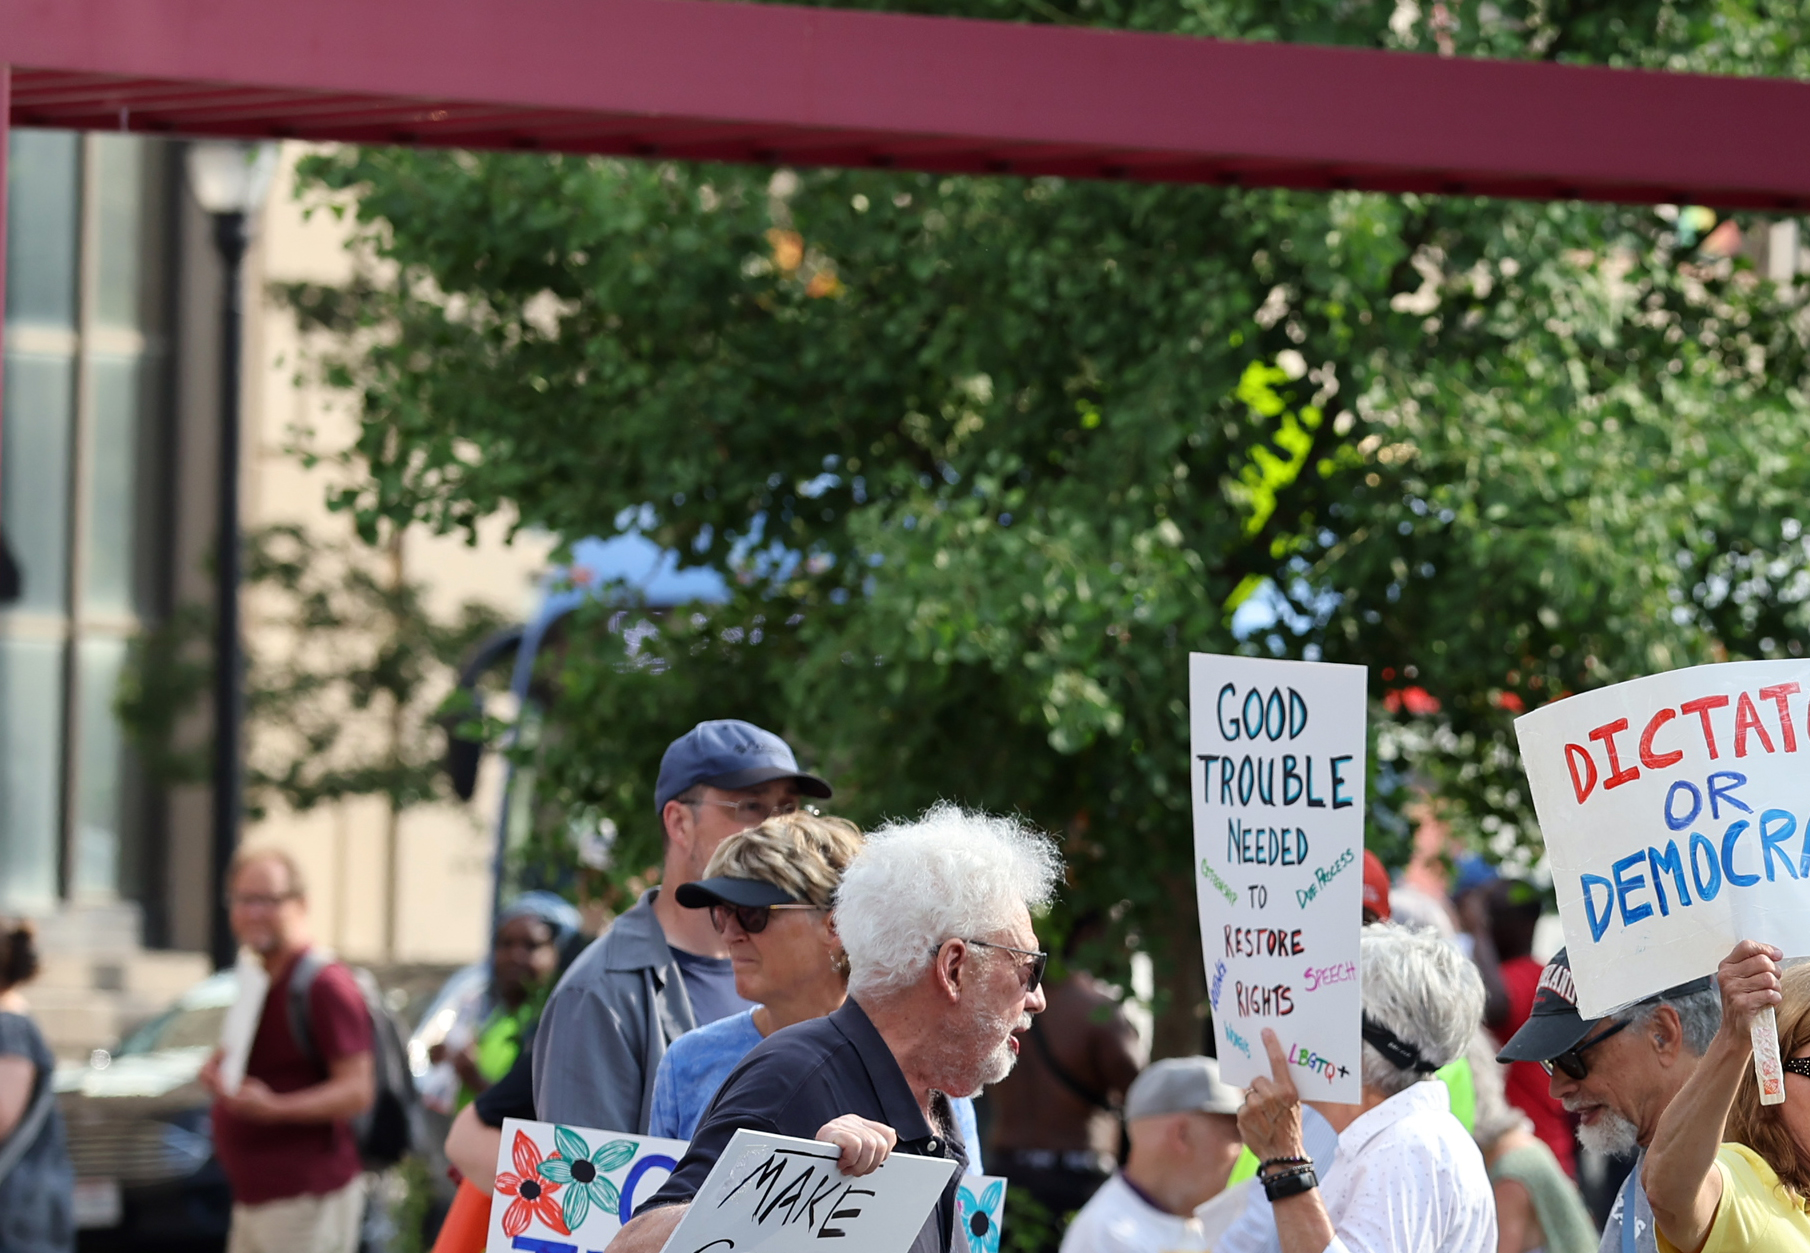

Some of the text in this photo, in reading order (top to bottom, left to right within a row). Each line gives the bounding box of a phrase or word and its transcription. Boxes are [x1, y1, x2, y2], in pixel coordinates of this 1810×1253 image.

[1217, 682, 1308, 741] GOOD
[1197, 755, 1354, 809] TROUBLE
[1664, 771, 1754, 831] OR
[1227, 818, 1309, 866] NEEDED
[1248, 885, 1267, 909] TO
[1224, 925, 1305, 957] RESTORE
[1236, 981, 1294, 1018] RIGHTS
[1304, 961, 1356, 992] SPEECH
[718, 1155, 875, 1239] MAKE
